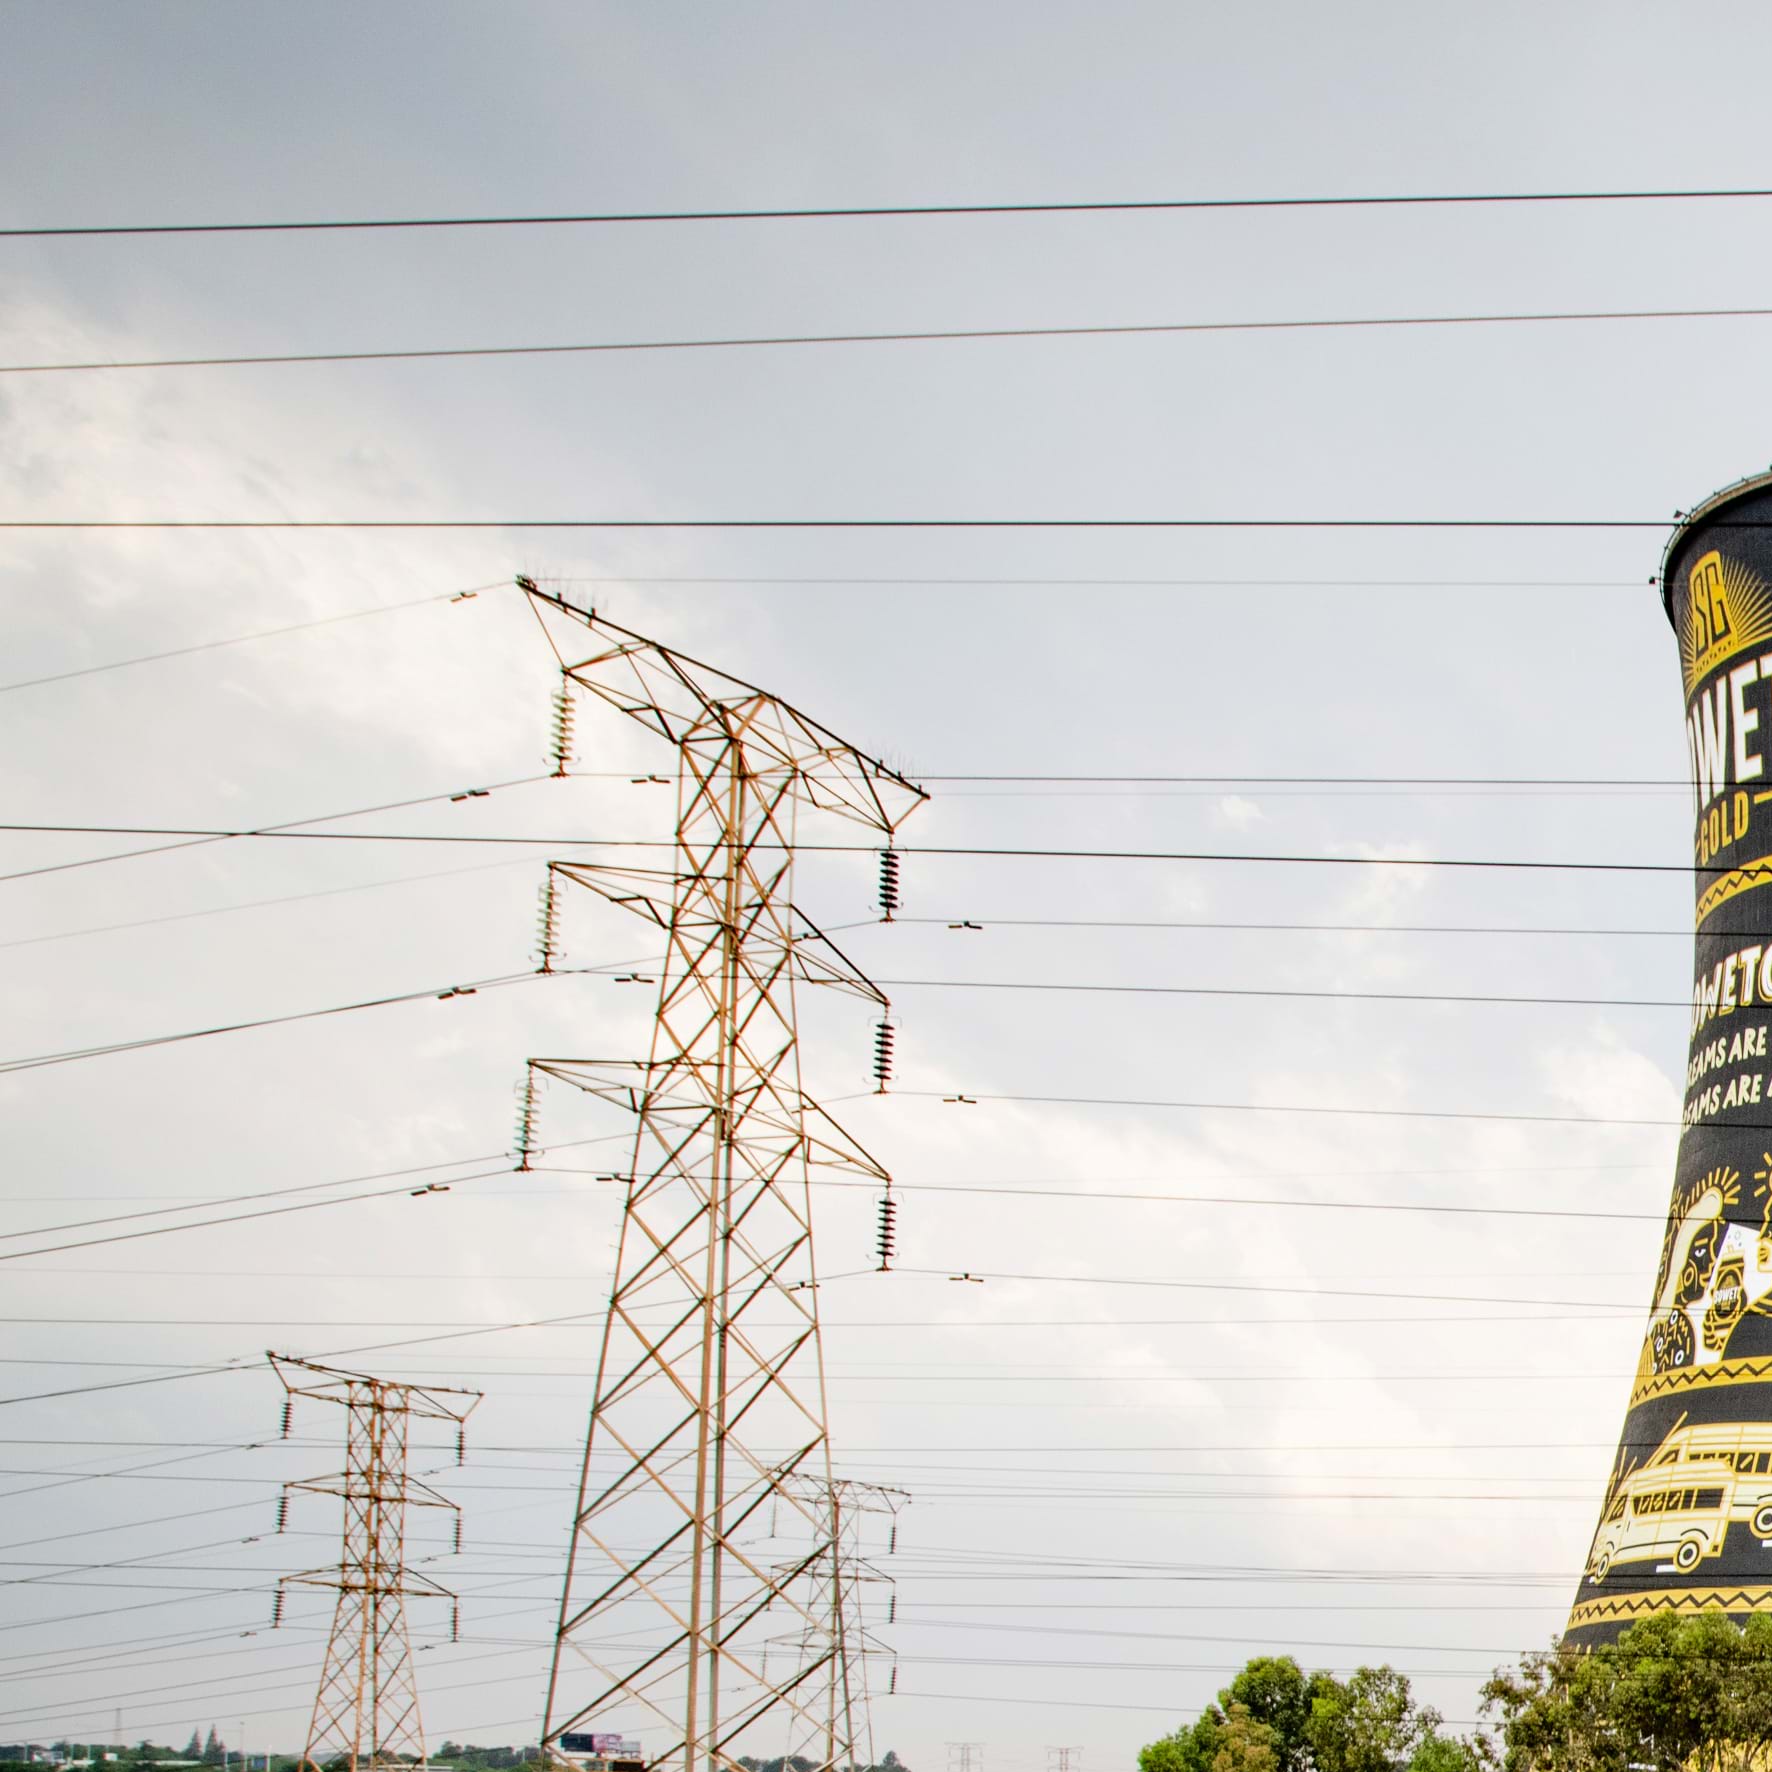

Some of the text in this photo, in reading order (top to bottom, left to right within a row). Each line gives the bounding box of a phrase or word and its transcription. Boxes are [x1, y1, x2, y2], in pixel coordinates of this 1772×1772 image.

[1700, 790, 1750, 866] GOLD
[1728, 1026, 1768, 1064] ARE
[1722, 1073, 1763, 1109] ARE
